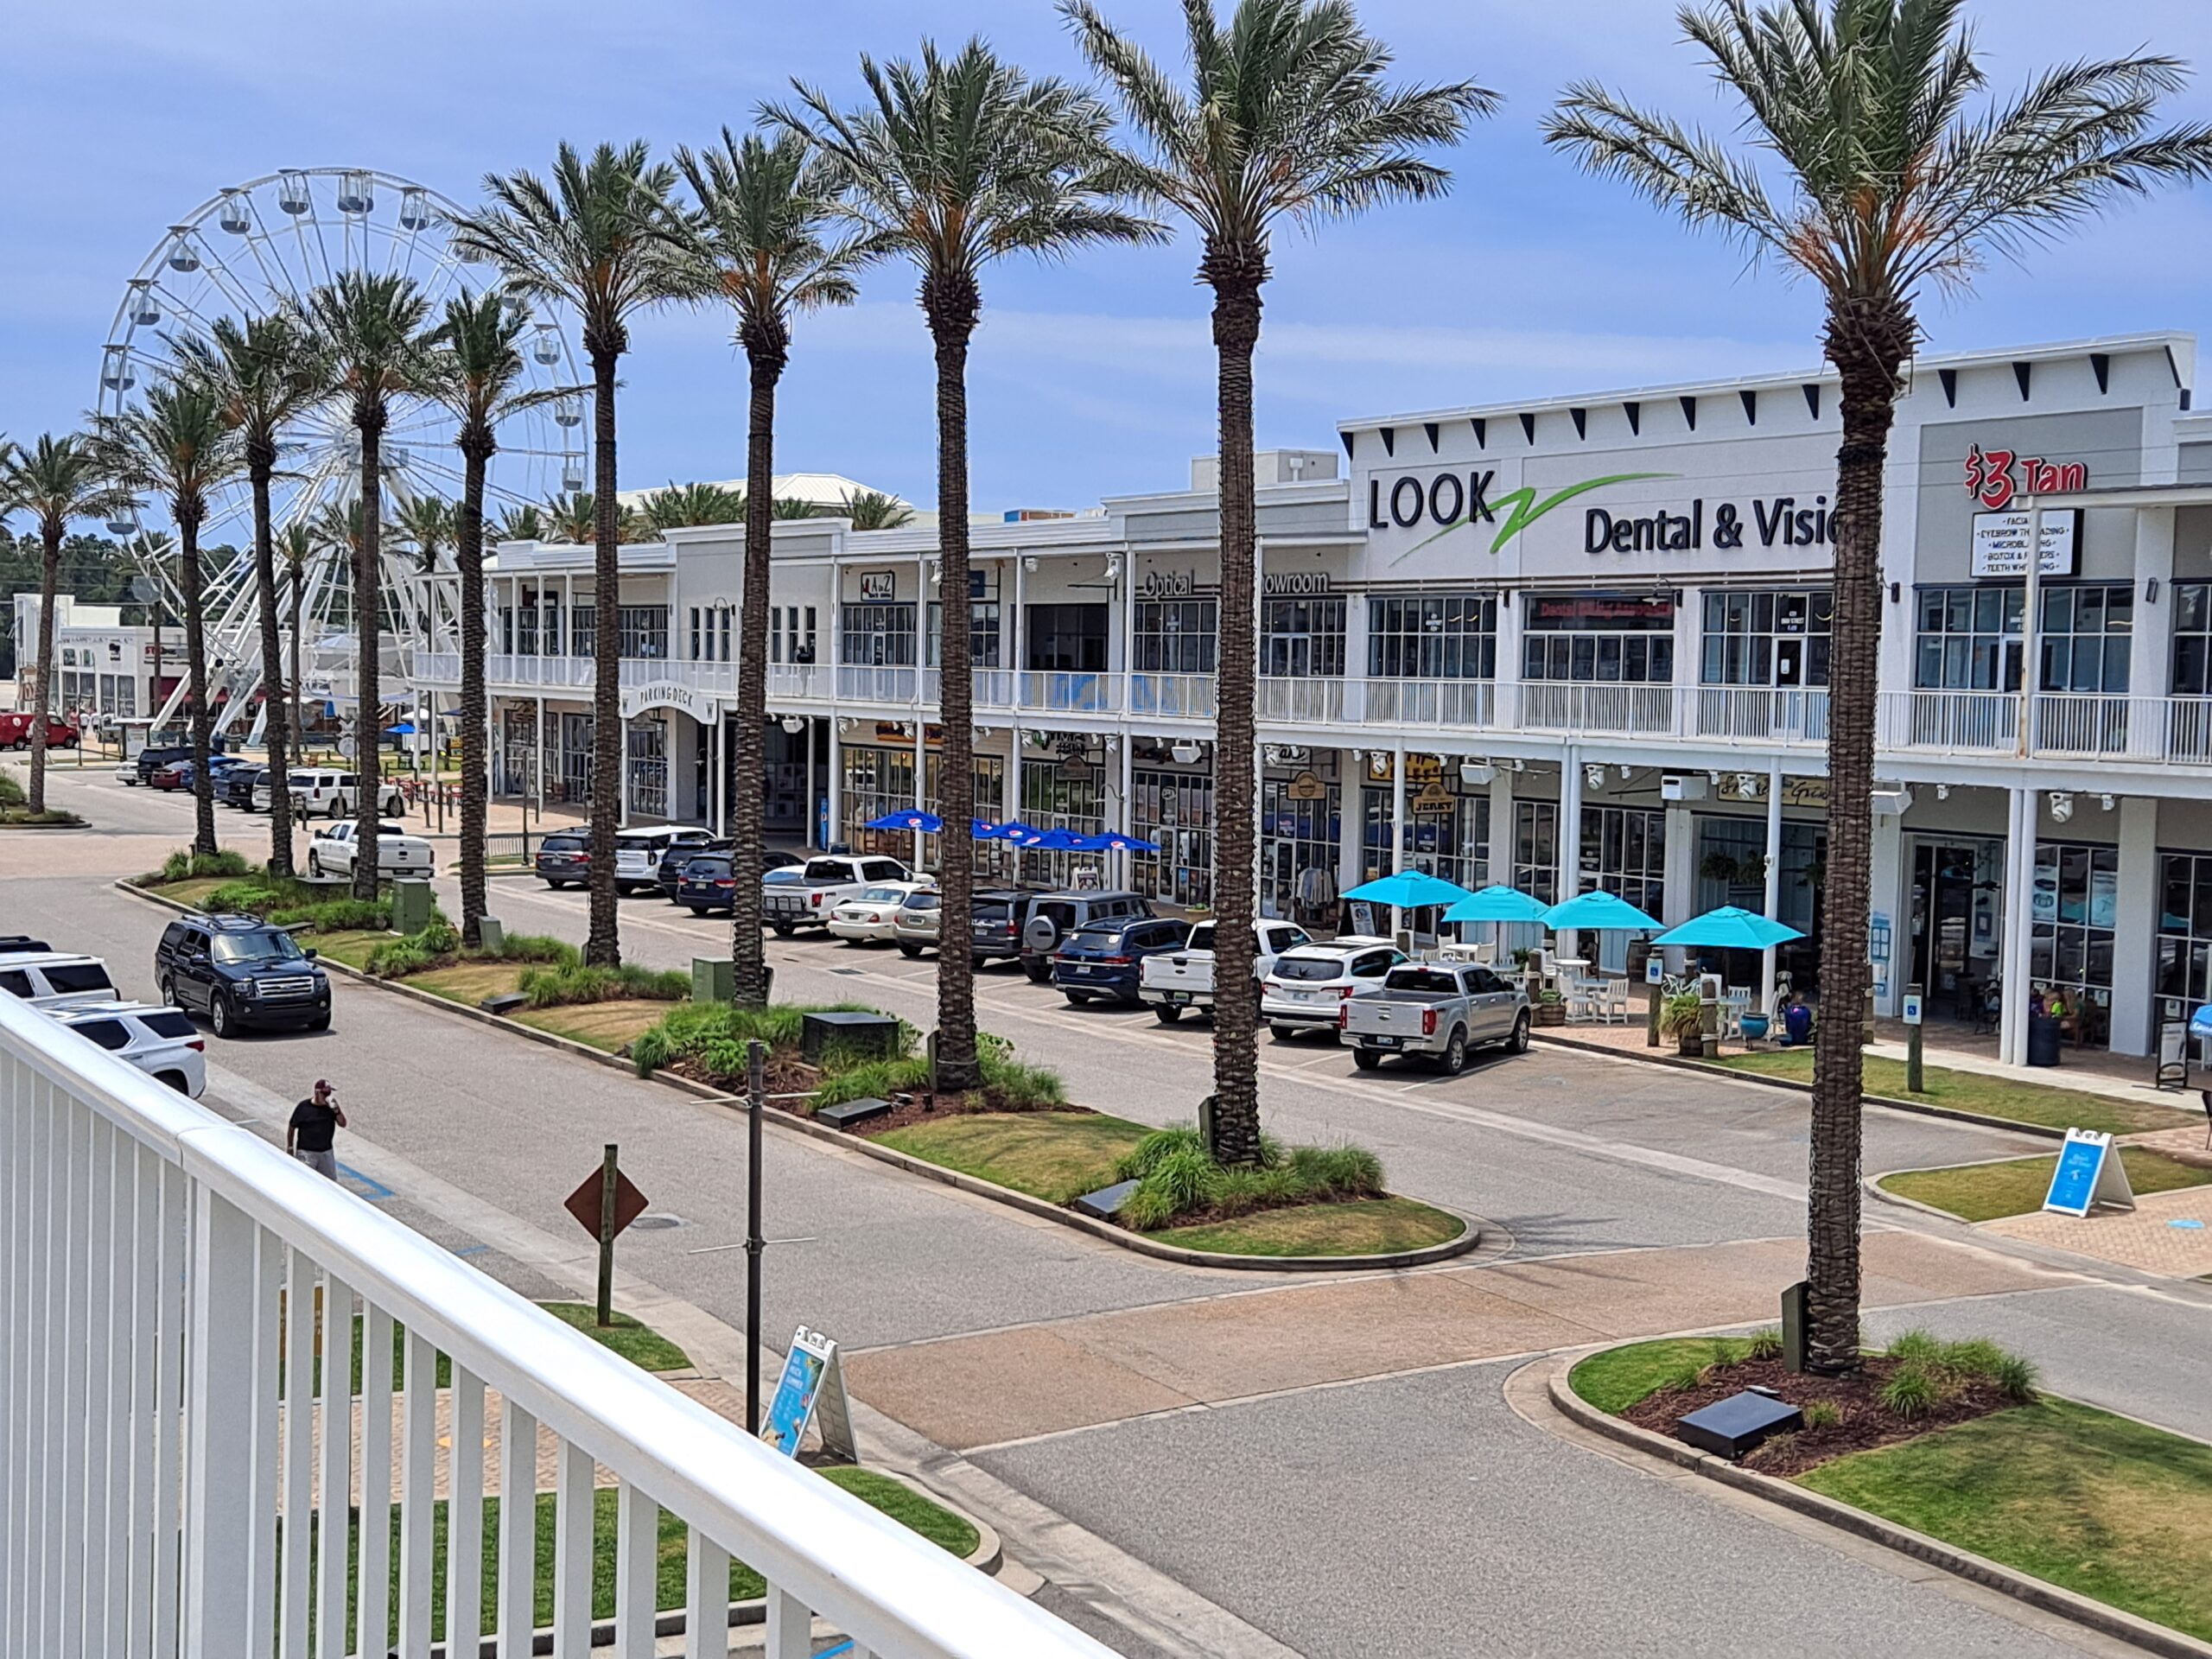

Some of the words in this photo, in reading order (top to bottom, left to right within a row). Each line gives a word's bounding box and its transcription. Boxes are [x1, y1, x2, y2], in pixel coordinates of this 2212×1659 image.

[1370, 470, 1496, 530] LOOK
[1964, 442, 2014, 509] $3
[2019, 457, 2085, 493] Tan
[1585, 499, 1703, 554] Dental
[1713, 503, 1743, 549] &
[1753, 495, 1839, 548] Visi
[1145, 569, 1194, 598] Optical
[640, 686, 671, 705] PARKING
[673, 688, 694, 707] DECK
